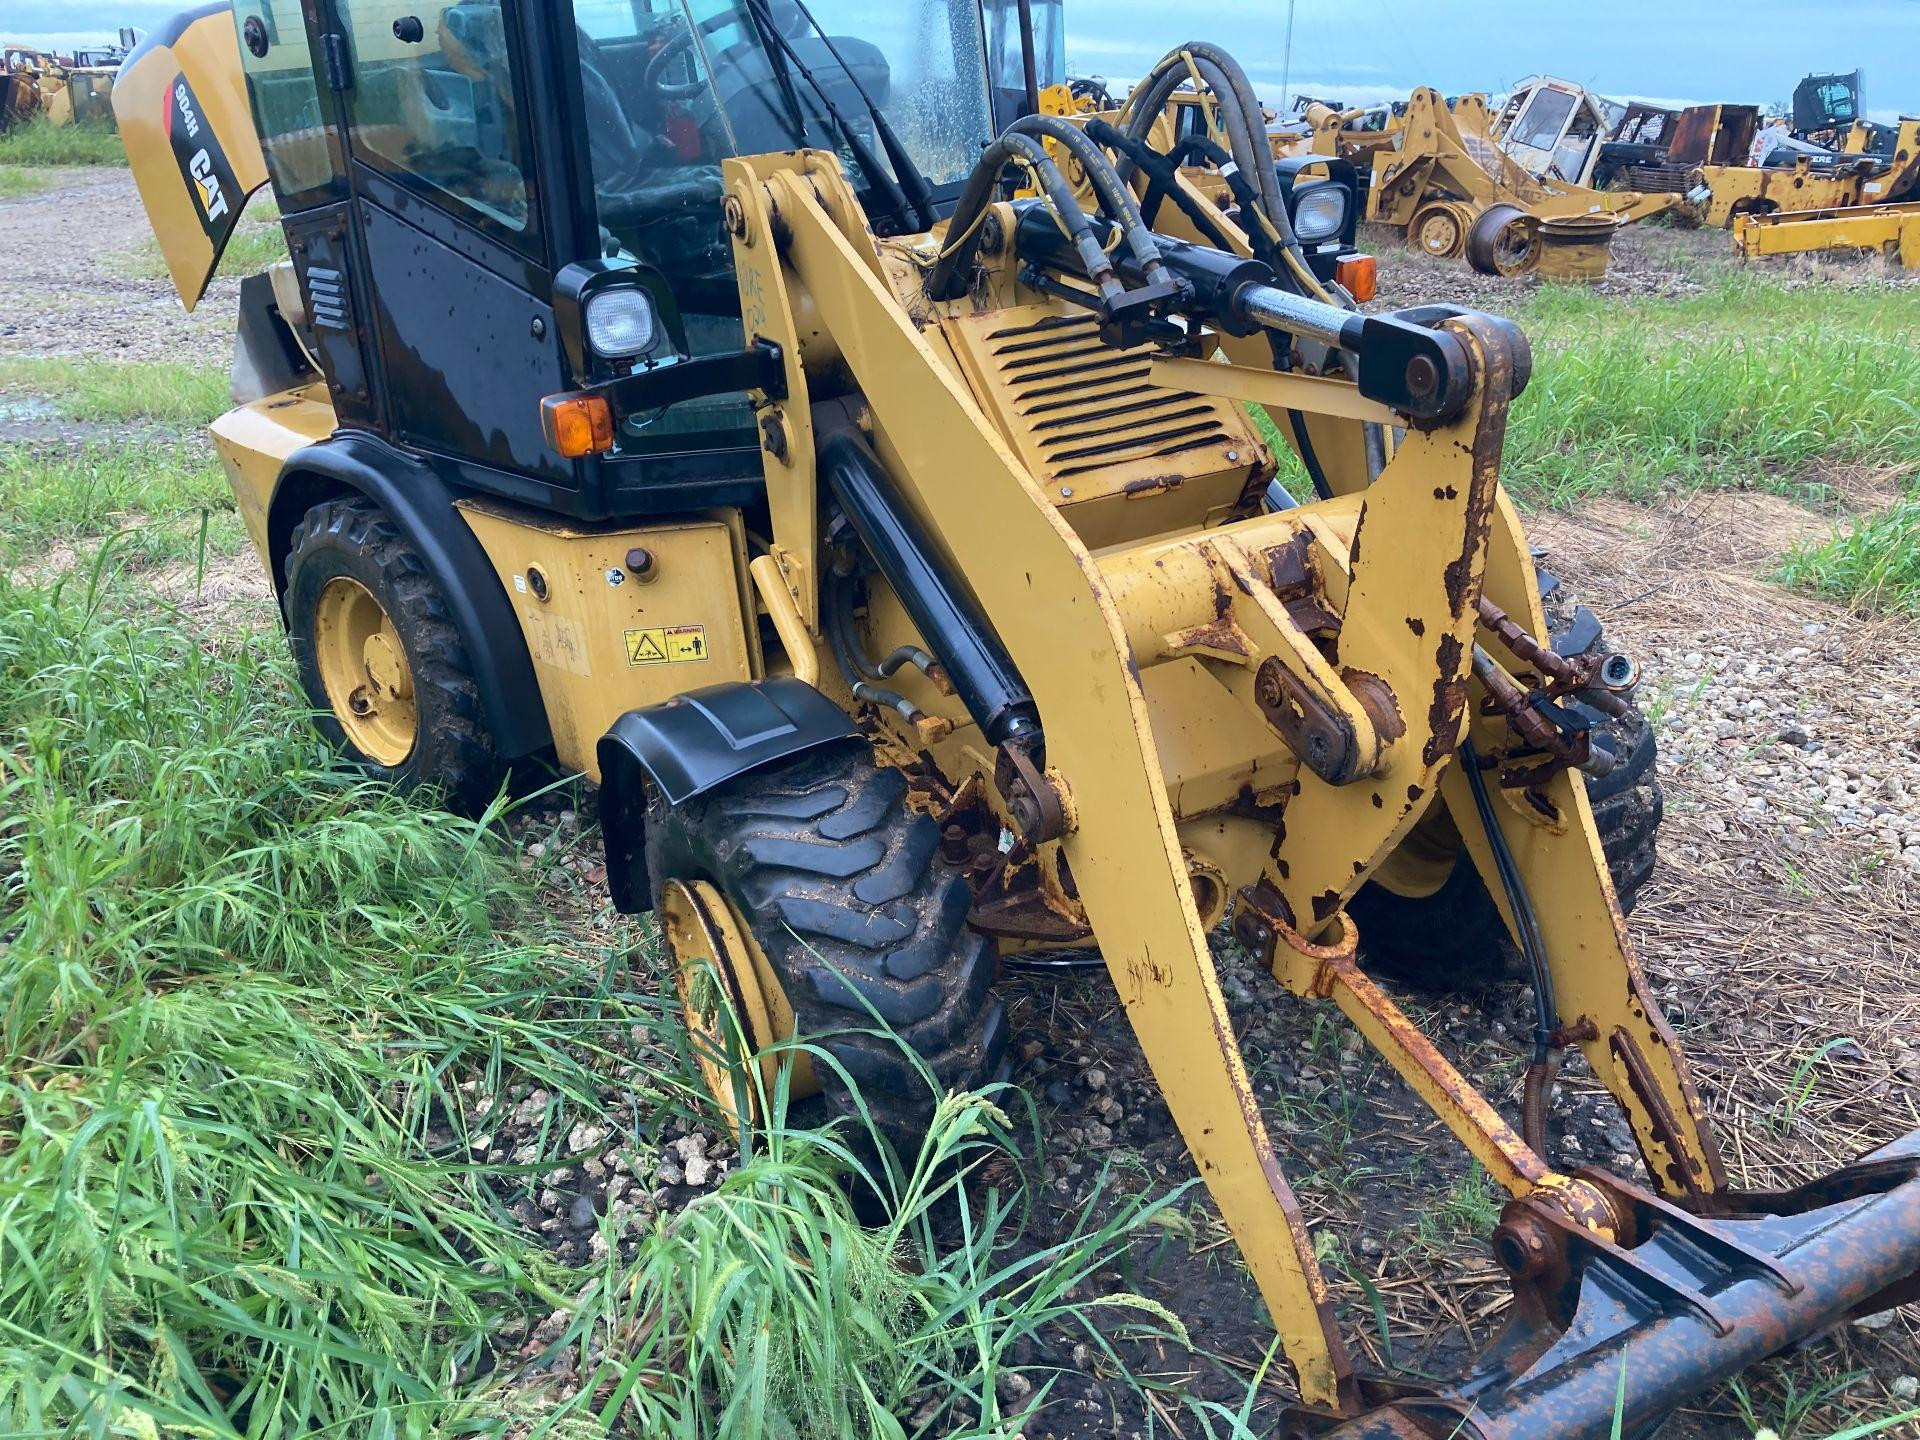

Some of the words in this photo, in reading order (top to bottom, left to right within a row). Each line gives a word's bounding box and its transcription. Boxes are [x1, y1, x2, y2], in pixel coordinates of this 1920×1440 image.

[175, 83, 199, 138] 904H
[189, 148, 228, 222] CAT
[1811, 155, 1833, 163] ERE
